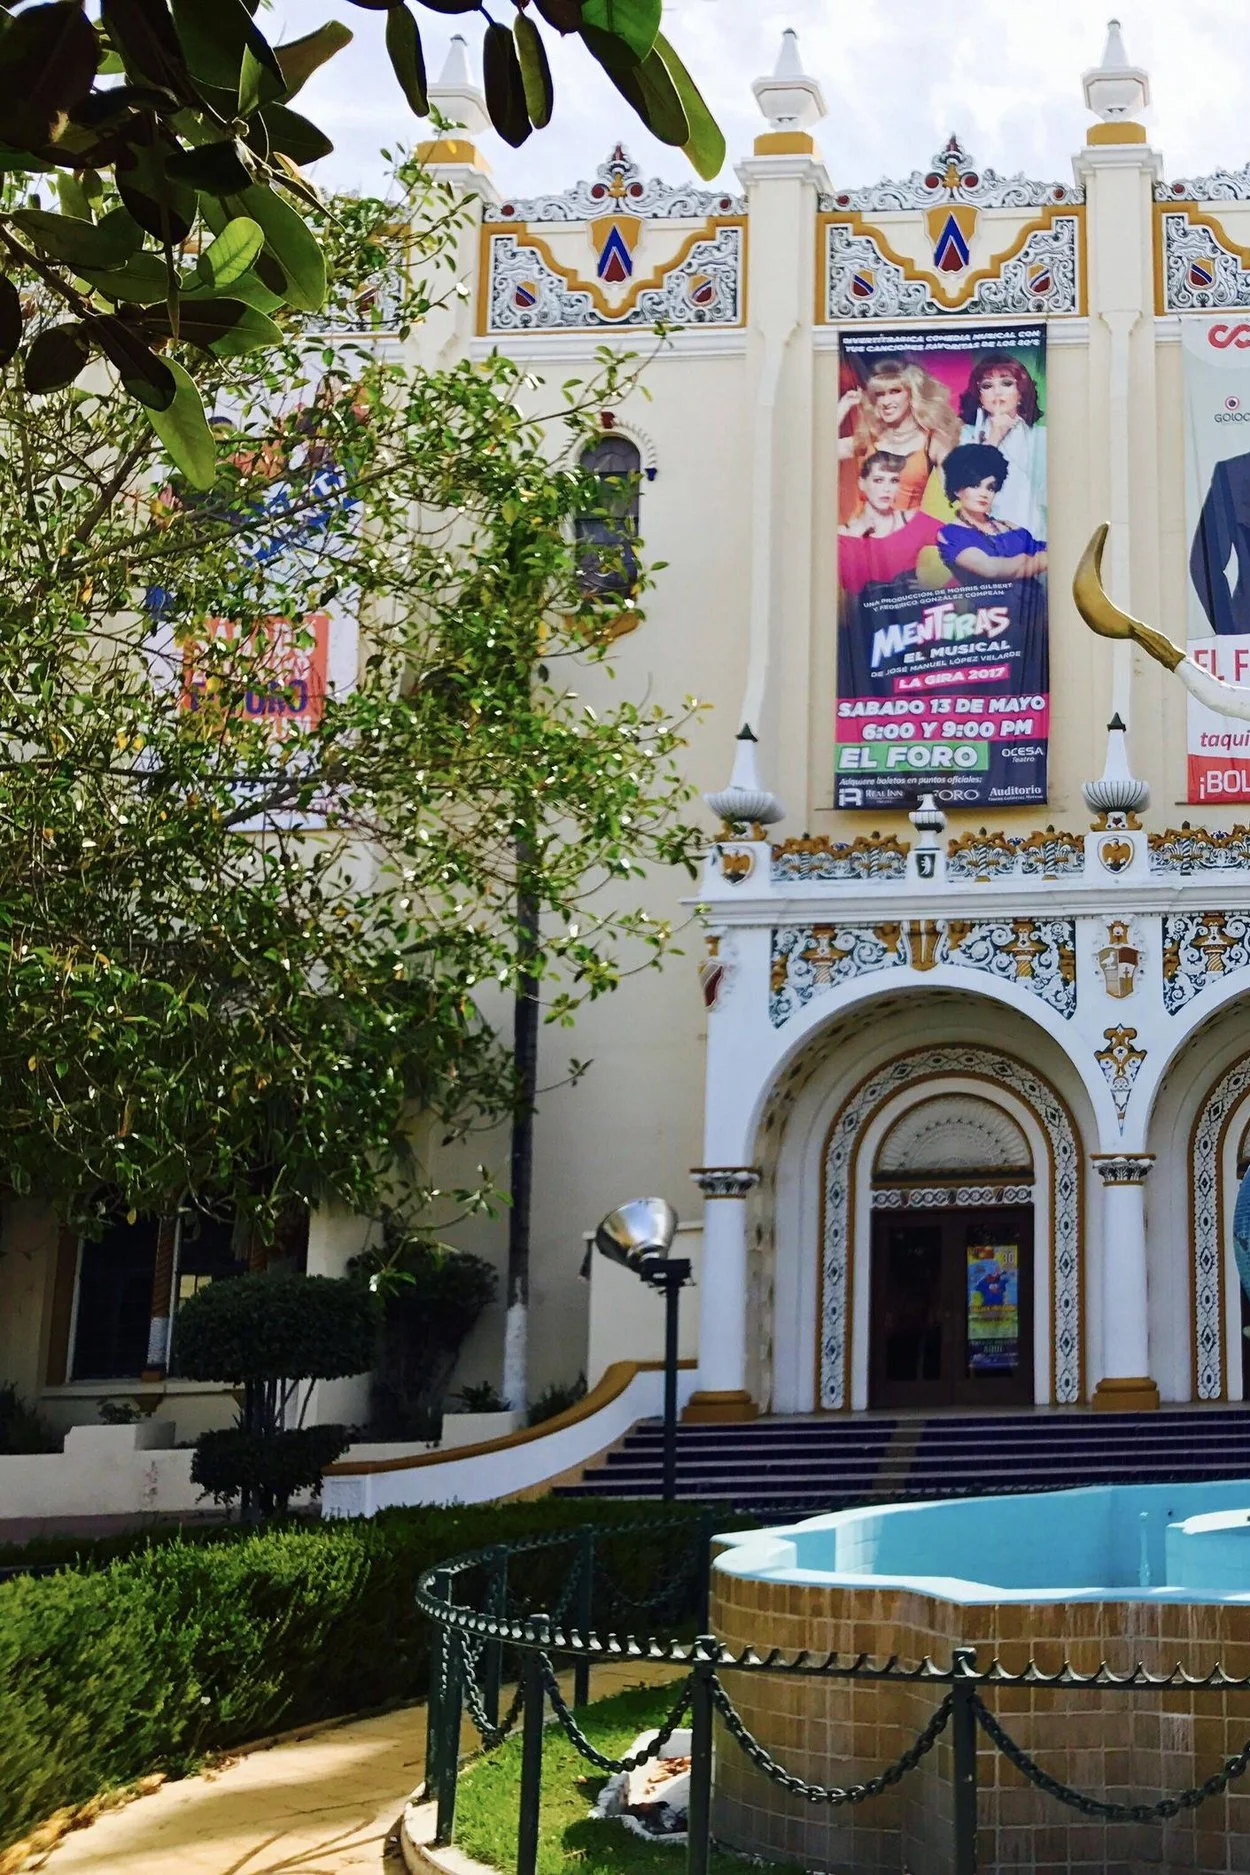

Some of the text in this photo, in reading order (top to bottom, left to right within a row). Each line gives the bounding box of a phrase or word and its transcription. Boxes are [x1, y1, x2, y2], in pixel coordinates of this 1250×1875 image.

[866, 344, 924, 352] CANCIONES
[981, 340, 996, 348] DE
[925, 334, 971, 343] COMEDIA
[972, 331, 1017, 340] MUSICAL
[1018, 329, 1041, 338] CON
[863, 600, 880, 608] UNA
[881, 590, 934, 604] PRODUCCIÓN
[947, 585, 978, 595] MORRIS
[980, 582, 1013, 591] GILBERT
[879, 601, 918, 611] FEDERICO
[919, 594, 965, 604] GONZÁLEZ
[965, 589, 1005, 599] COMPEÁN
[903, 640, 1011, 664] EL MUSICAL
[909, 660, 947, 671] MANUEL
[949, 655, 979, 666] LÓPEZ
[980, 650, 1022, 662] VELARDE
[1194, 648, 1225, 681] EL
[899, 666, 1006, 689] LA GIRA 2017
[837, 695, 1046, 718] SABADO 13 DE MAYO
[862, 719, 1033, 740] 6:00 Y 9:00 PM
[838, 745, 978, 769] EL FORO
[1001, 747, 1044, 757] OCESA
[839, 778, 876, 787] Adquiere
[876, 776, 906, 785] boletos
[918, 776, 946, 785] puntos
[947, 775, 982, 785] oficiales:
[989, 784, 1042, 797] Auditorio
